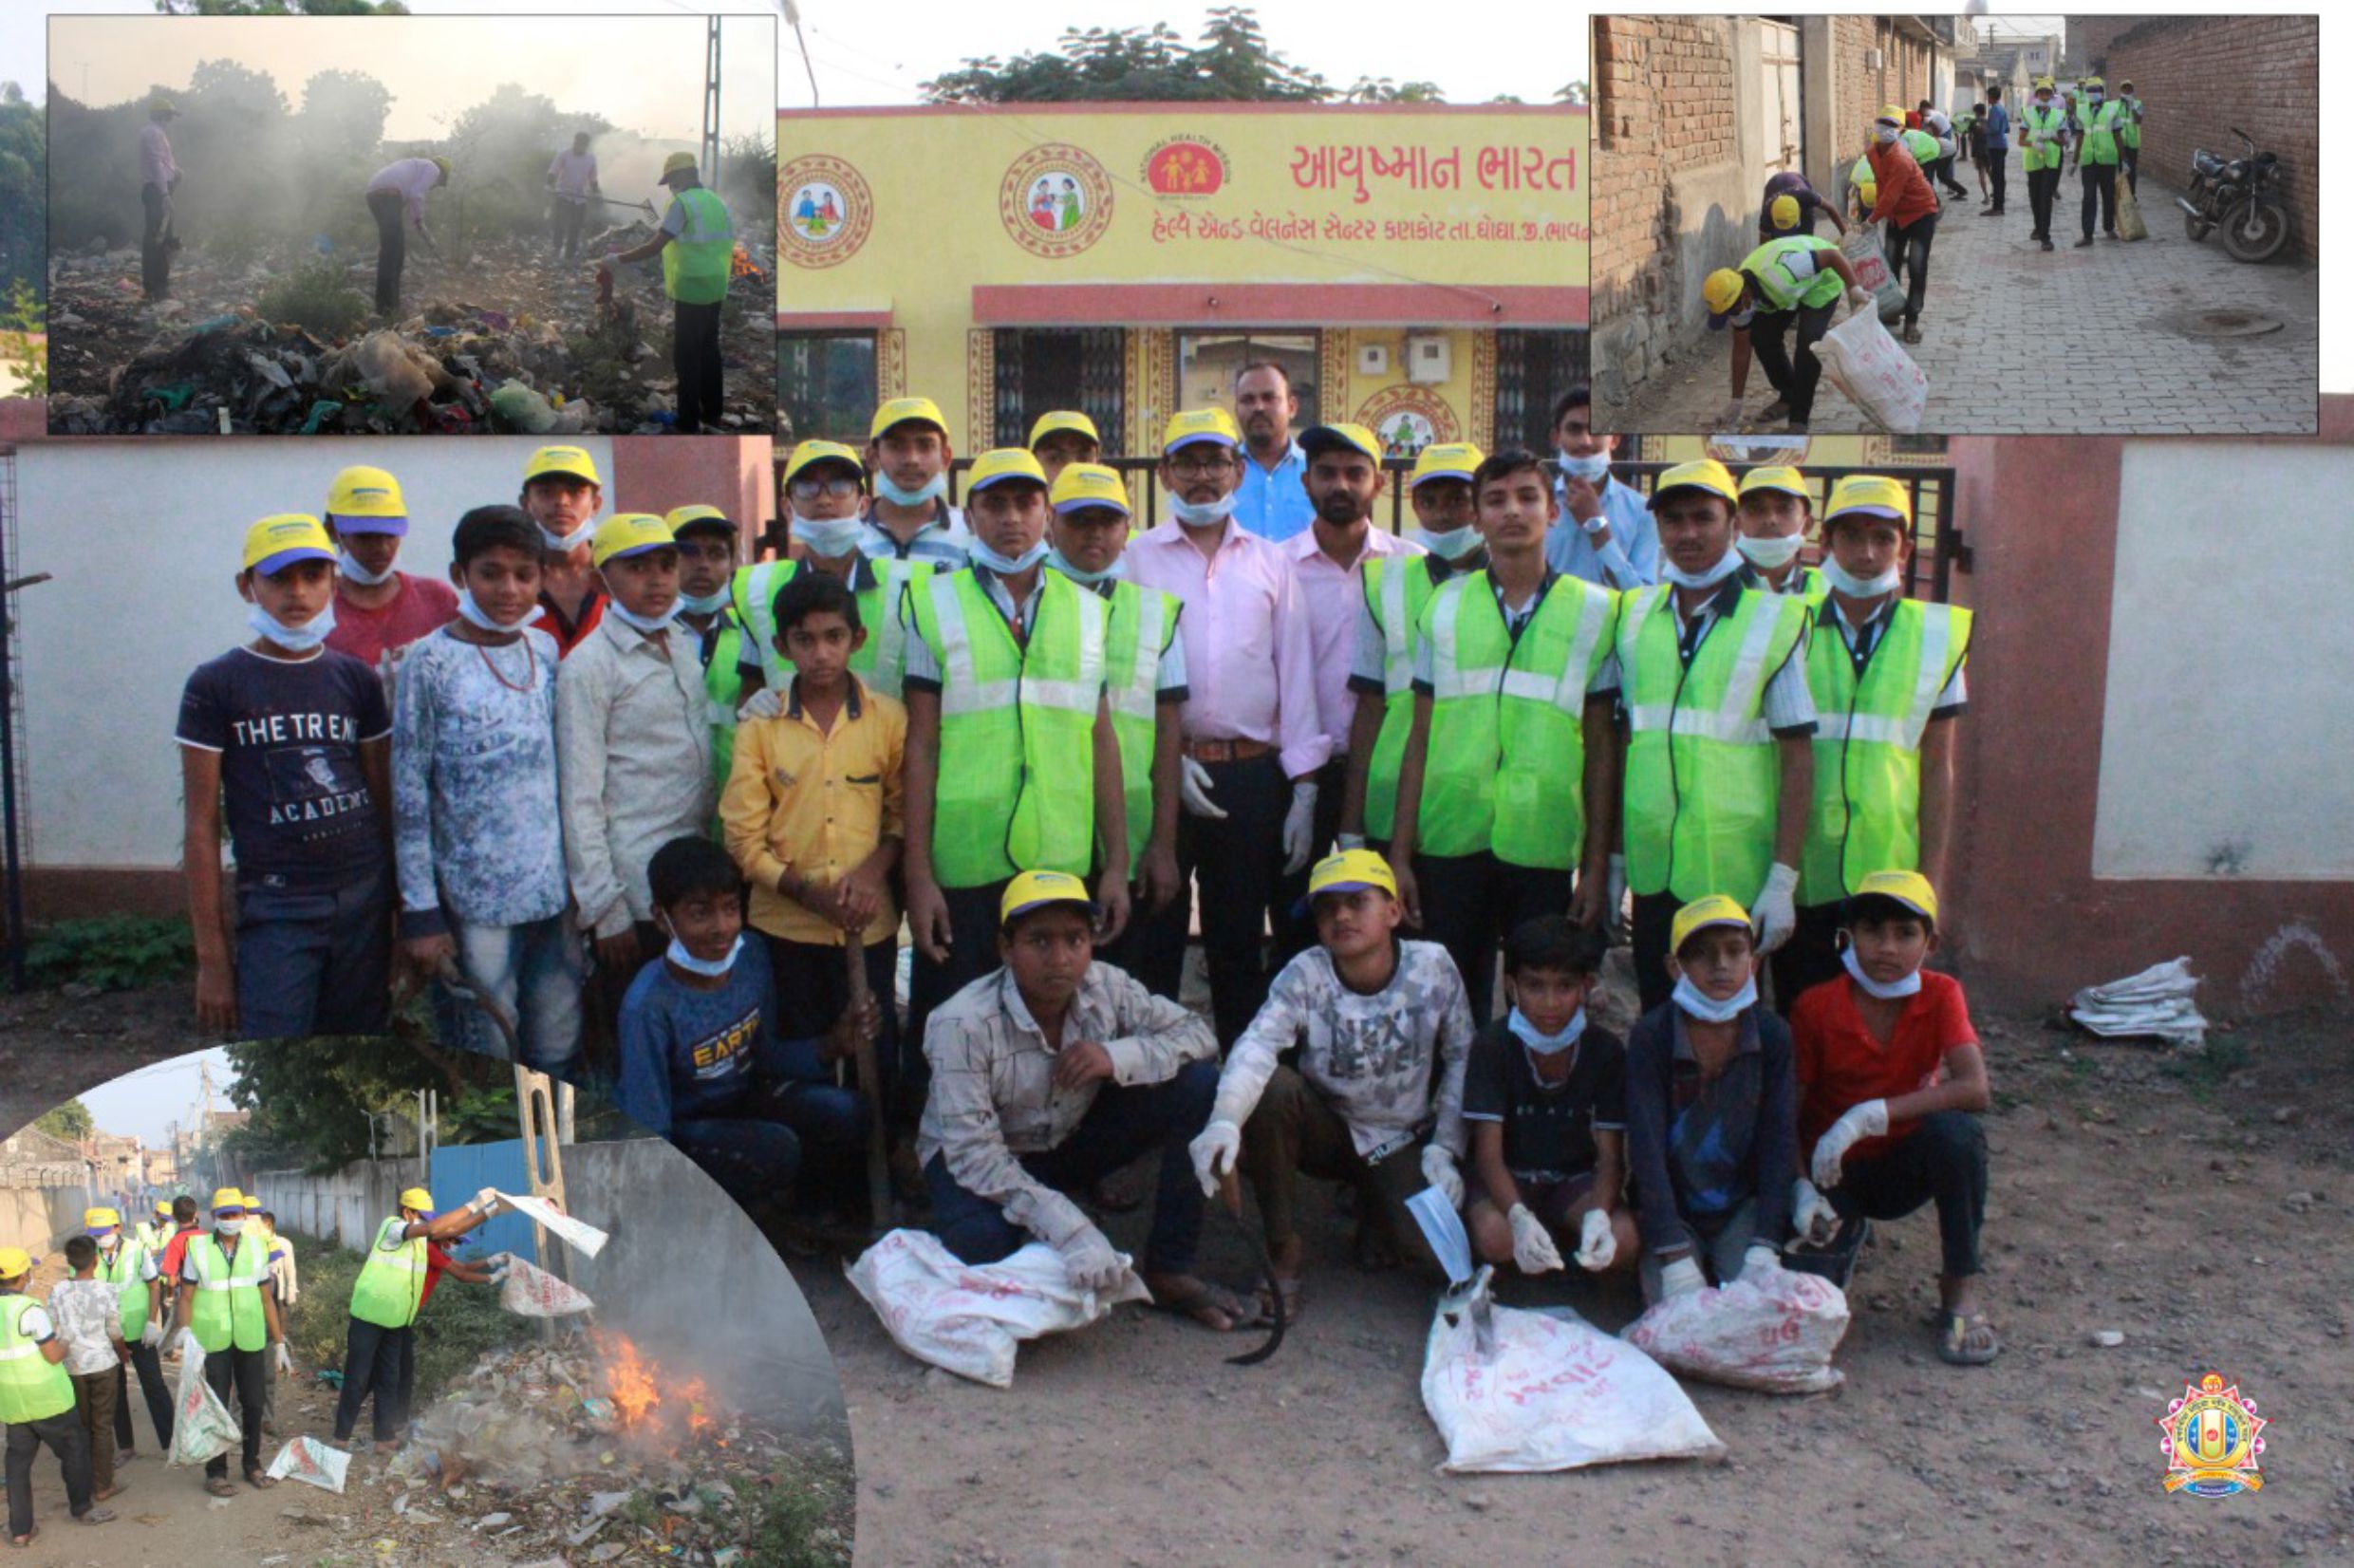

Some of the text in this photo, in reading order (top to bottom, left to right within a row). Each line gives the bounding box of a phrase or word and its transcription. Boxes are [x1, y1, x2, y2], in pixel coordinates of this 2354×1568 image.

[1288, 144, 1577, 204] આયુષ્માન ભારત
[1248, 210, 1317, 240] વેલનેસ
[1323, 212, 1376, 240] સેન્ટર
[233, 715, 288, 747] THE
[1330, 1006, 1425, 1055] NEXT
[1328, 1047, 1427, 1079] LEVEL
